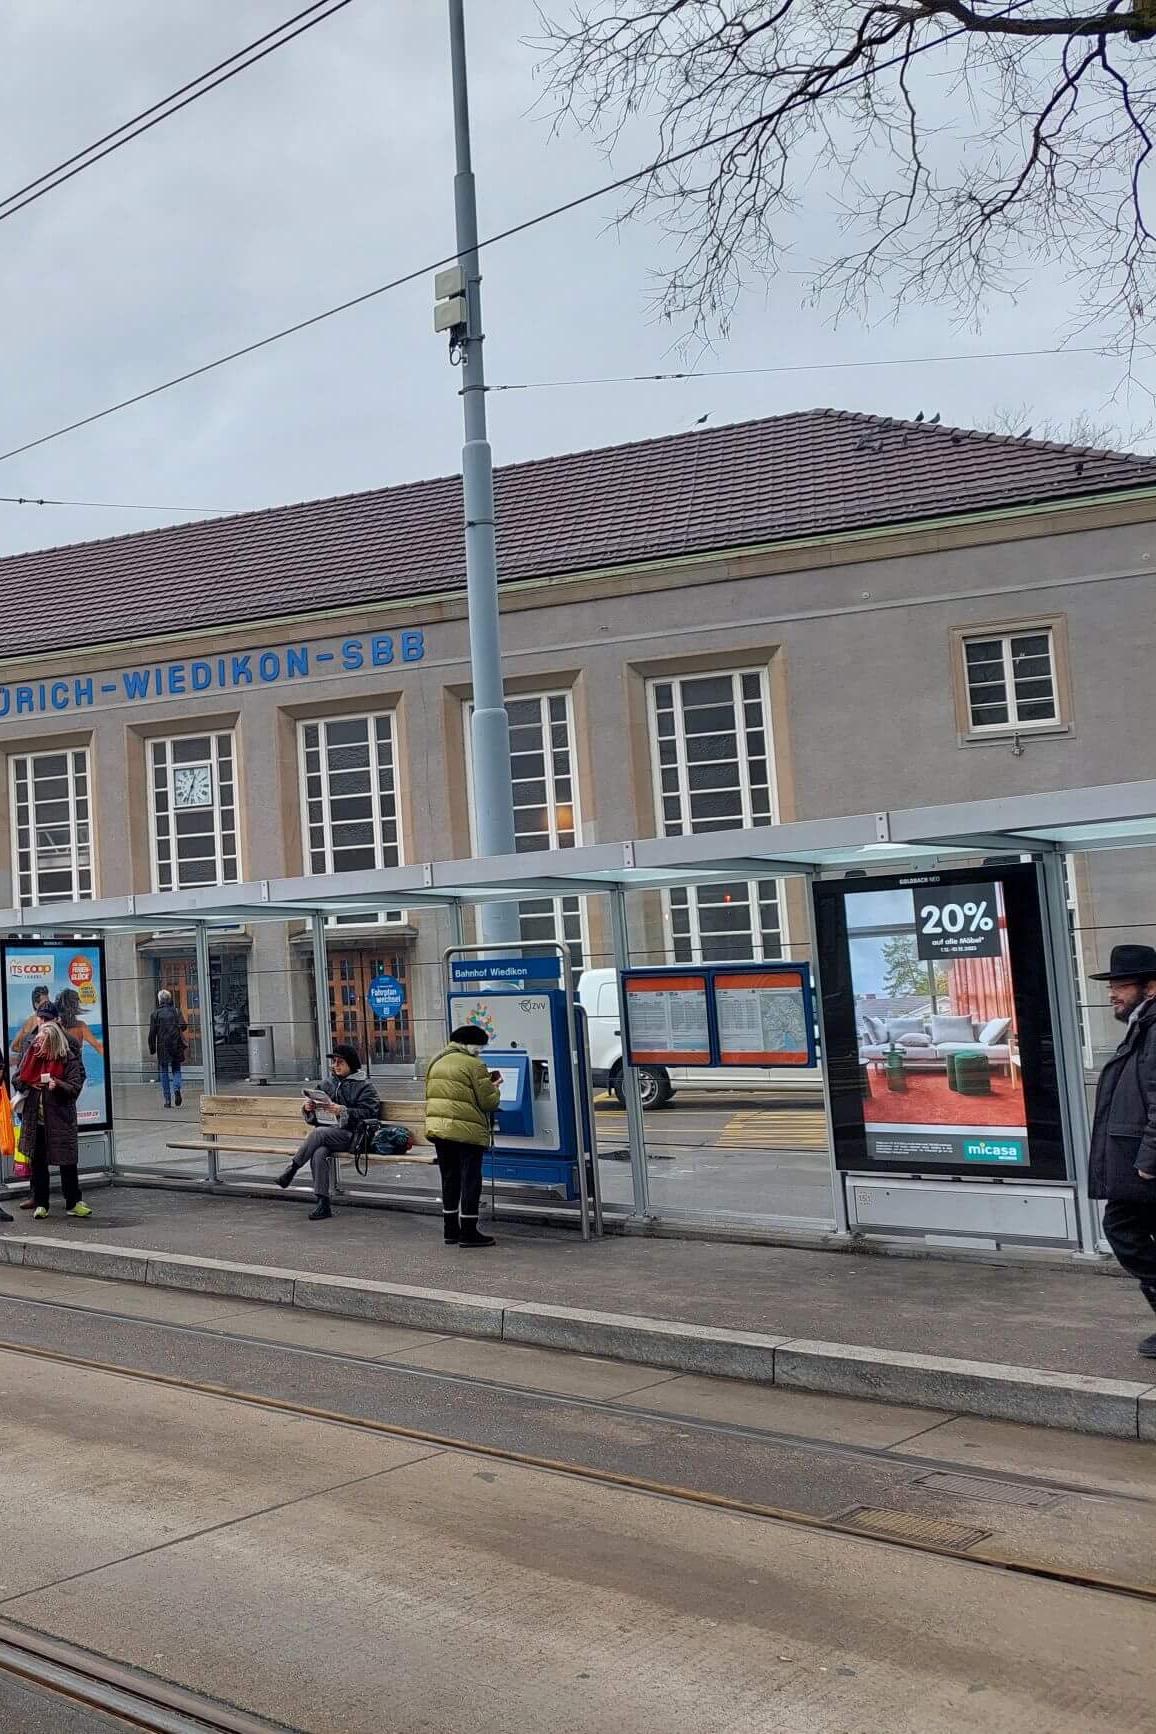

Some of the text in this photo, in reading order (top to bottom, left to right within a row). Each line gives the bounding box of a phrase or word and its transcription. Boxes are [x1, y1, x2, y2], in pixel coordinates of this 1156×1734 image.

[920, 901, 994, 934] 20%
[932, 938, 943, 946] auf
[945, 937, 958, 945] alle
[455, 967, 528, 978] Bahnhof Wiedikon
[532, 1001, 546, 1010] ZVV
[968, 1142, 1017, 1156] micasa
